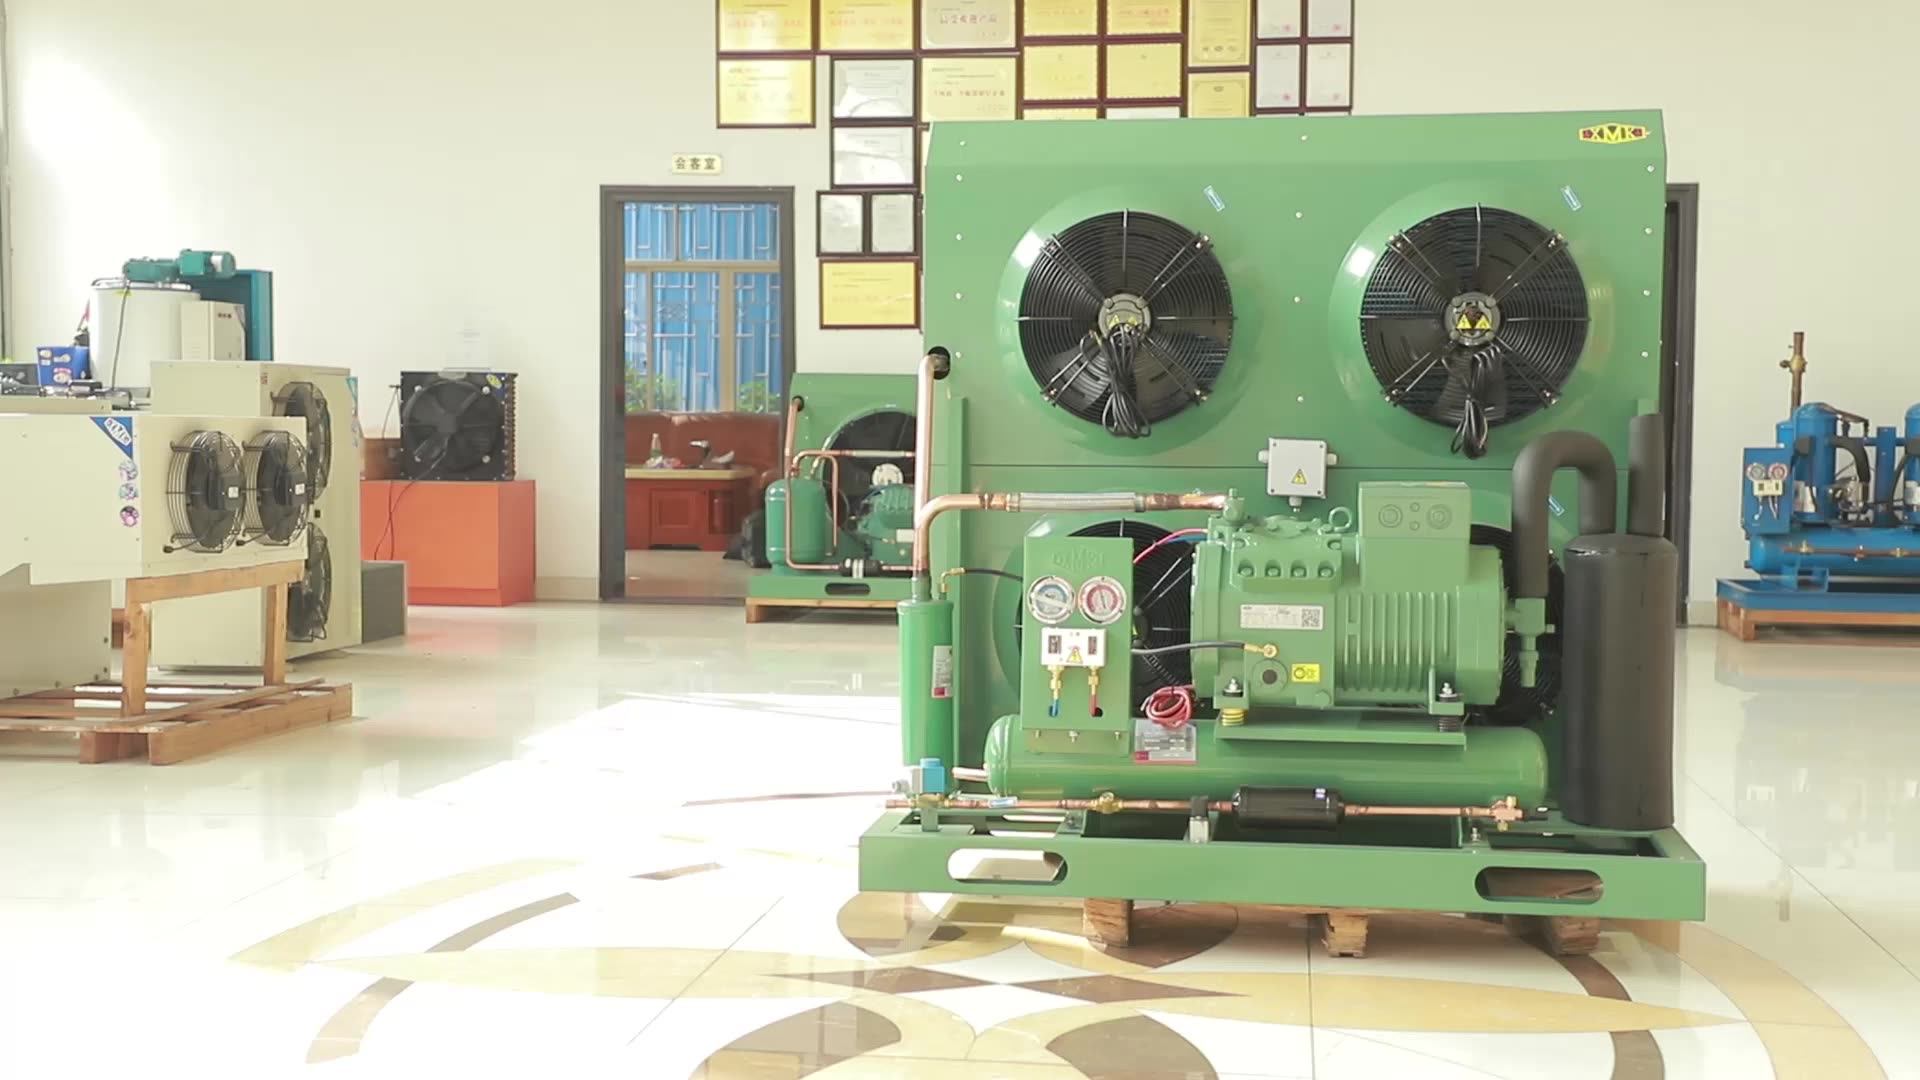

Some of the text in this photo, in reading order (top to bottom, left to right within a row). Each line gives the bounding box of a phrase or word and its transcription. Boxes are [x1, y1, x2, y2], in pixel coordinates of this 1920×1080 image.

[1584, 123, 1641, 143] XMK
[674, 157, 716, 170] 会客室
